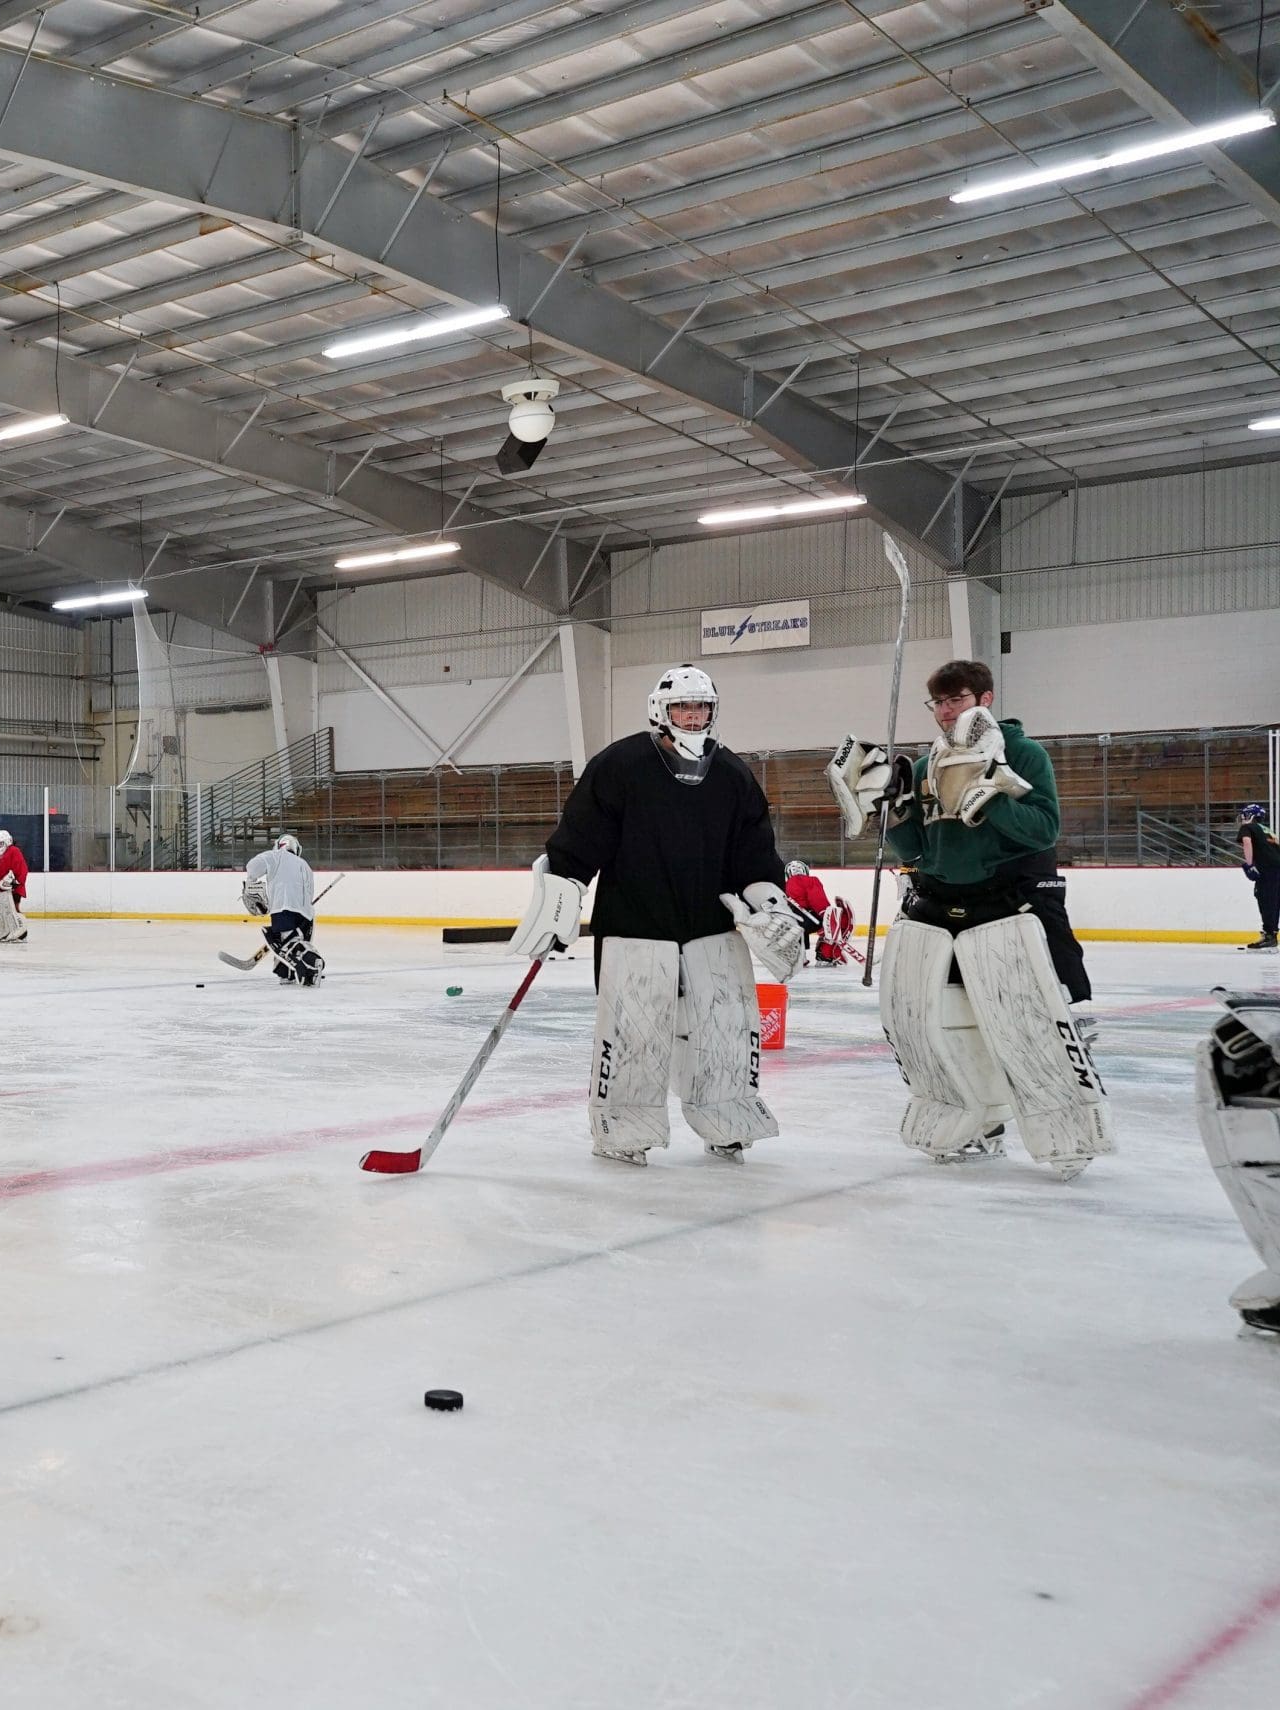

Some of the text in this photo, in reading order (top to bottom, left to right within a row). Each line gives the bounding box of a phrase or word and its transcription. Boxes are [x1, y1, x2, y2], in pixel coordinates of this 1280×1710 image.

[703, 617, 809, 638] BLUE STREAKS
[834, 734, 855, 768] Reebok
[963, 788, 986, 812] Reebok
[598, 1040, 612, 1100] CCM
[749, 1031, 760, 1089] CCM
[1056, 1020, 1094, 1090] CCM
